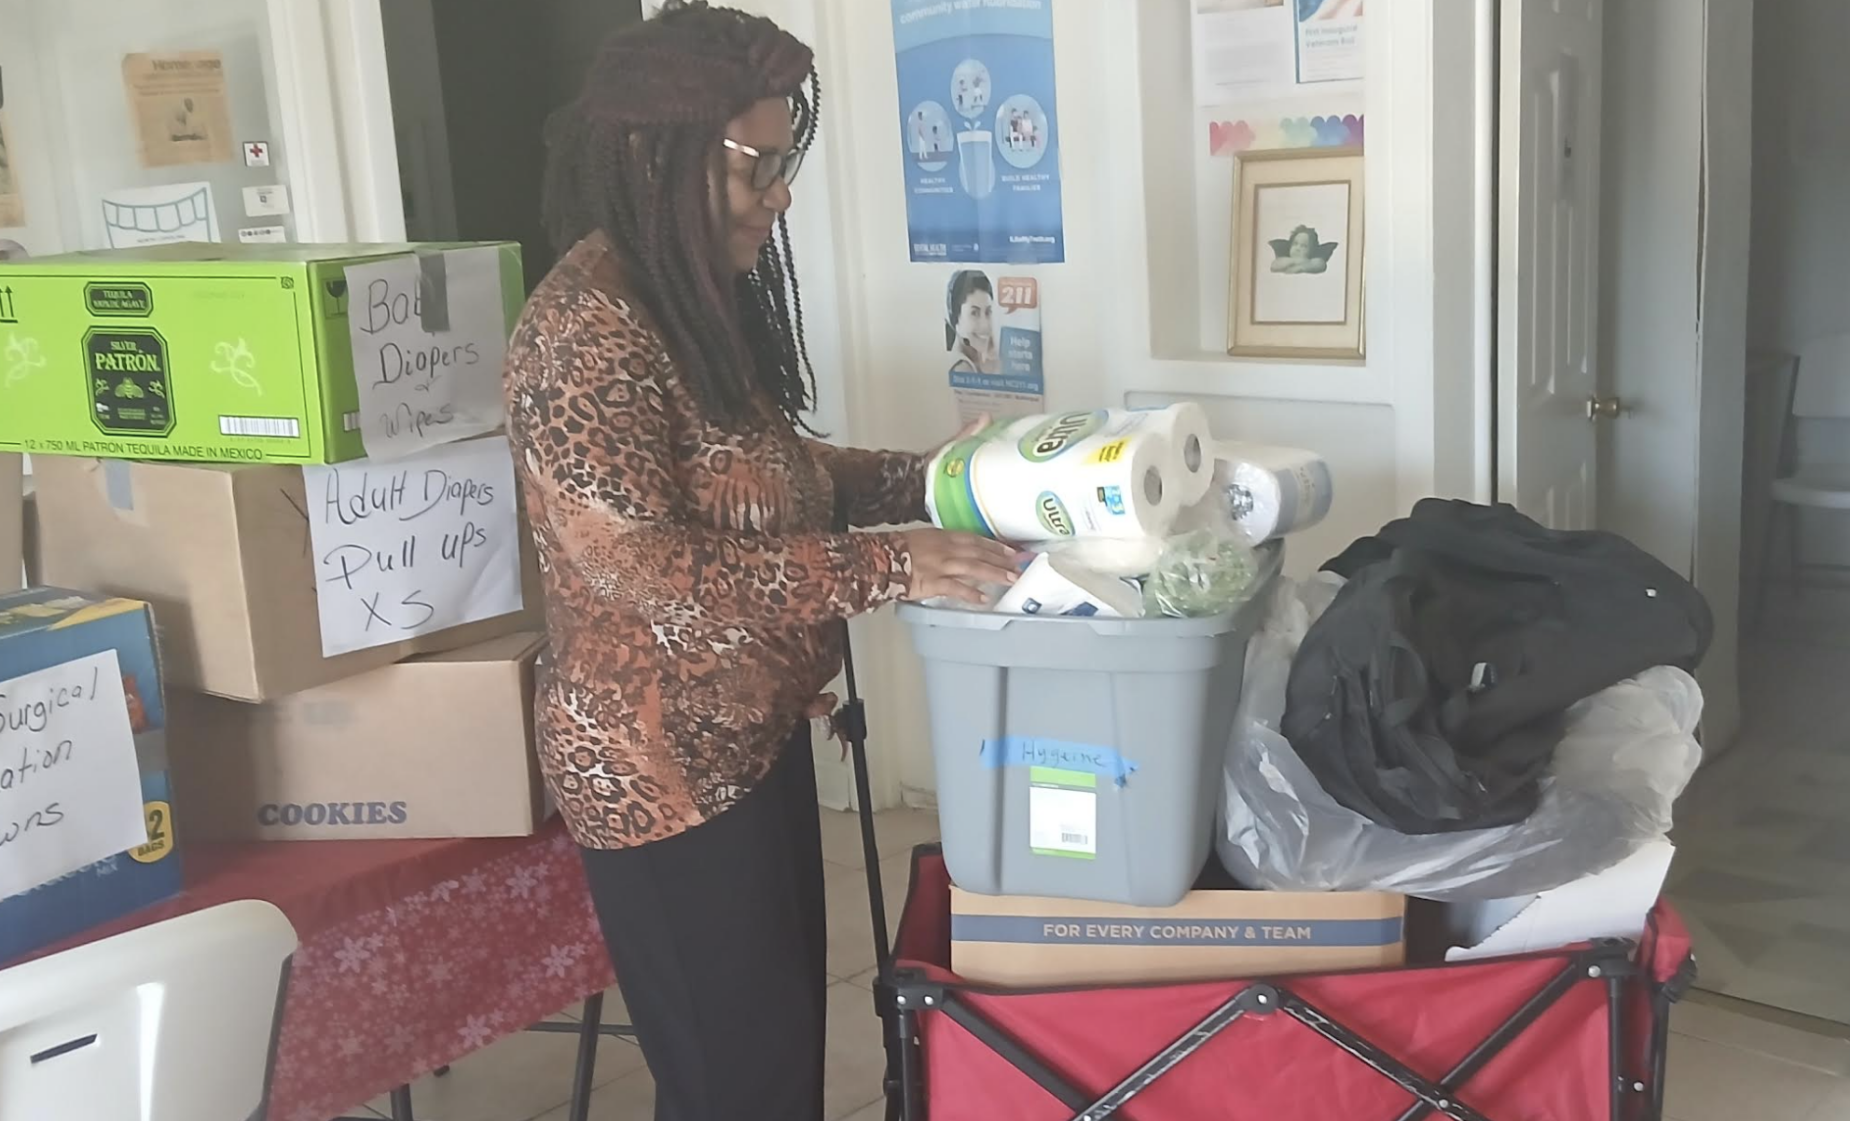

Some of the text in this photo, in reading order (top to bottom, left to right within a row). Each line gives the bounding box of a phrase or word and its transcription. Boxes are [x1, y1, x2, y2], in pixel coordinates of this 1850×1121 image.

[900, 2, 953, 24] community
[1021, 173, 1050, 181] HEALTHY
[103, 290, 133, 299] TEQUILA
[1000, 286, 1032, 304] 211
[110, 340, 137, 351] SILVER
[1010, 336, 1030, 349] Help
[95, 349, 161, 372] PATRÓN
[372, 343, 480, 390] Diapers
[1011, 361, 1030, 372] here
[1037, 412, 1093, 453] Ultra
[24, 439, 36, 450] 12
[45, 440, 63, 451] 750
[66, 440, 81, 452] ML
[126, 443, 171, 455] TEQUILA
[173, 445, 205, 457] MADE
[206, 447, 217, 457] IN
[221, 447, 262, 460] MEXICO
[326, 467, 494, 525] Adult Diapers
[1043, 498, 1070, 535] Ultra
[323, 535, 416, 590] Pull
[257, 801, 407, 826] COOKIES
[138, 840, 165, 856] BAGS
[1043, 923, 1311, 939] FOR EVERY COMPANY & TEAM
